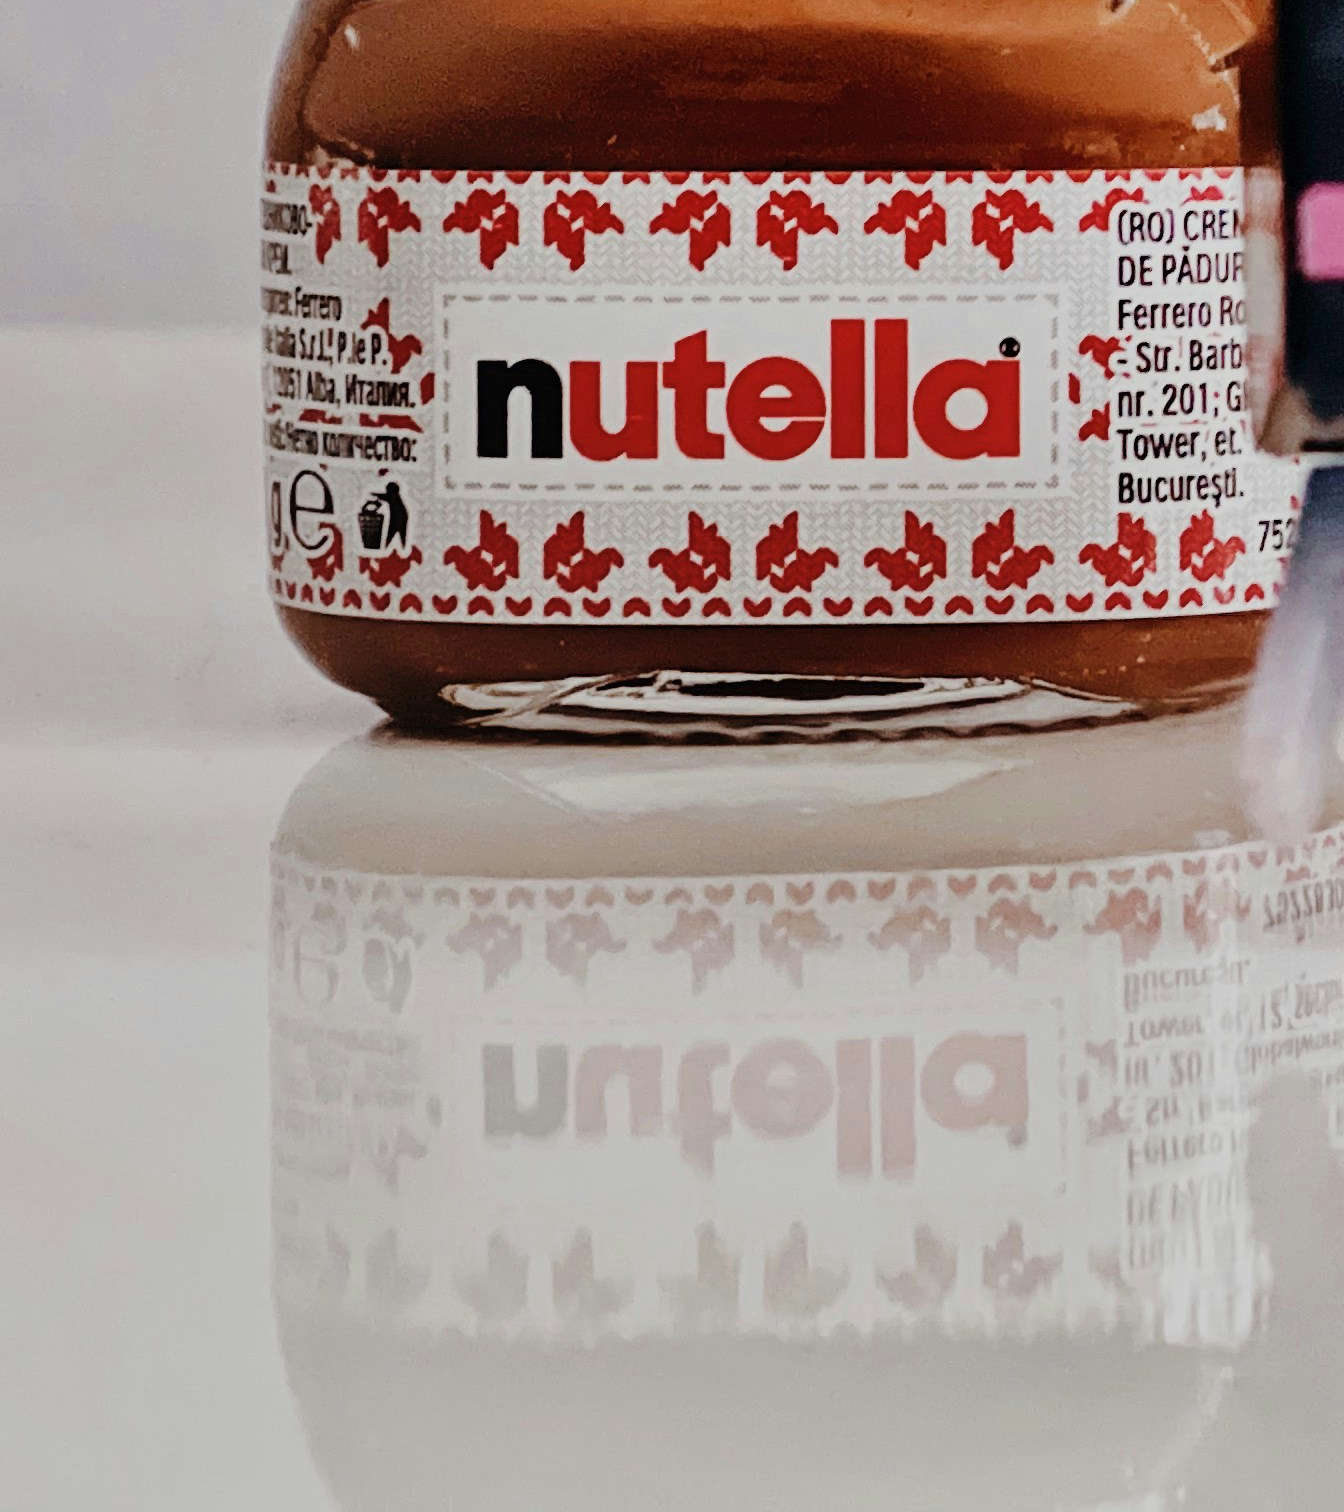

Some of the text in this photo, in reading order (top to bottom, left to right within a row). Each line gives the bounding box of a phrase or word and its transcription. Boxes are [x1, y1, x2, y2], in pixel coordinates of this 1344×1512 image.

[1118, 208, 1175, 247] (RO)
[1118, 255, 1153, 287] DE
[1117, 299, 1212, 331] Ferrero
[371, 332, 389, 367] P.
[1136, 342, 1180, 374] Str.
[477, 317, 1021, 462] nutella
[1118, 390, 1154, 418] nr.
[1162, 382, 1220, 418] 201;
[1116, 427, 1243, 463] Tower, et.
